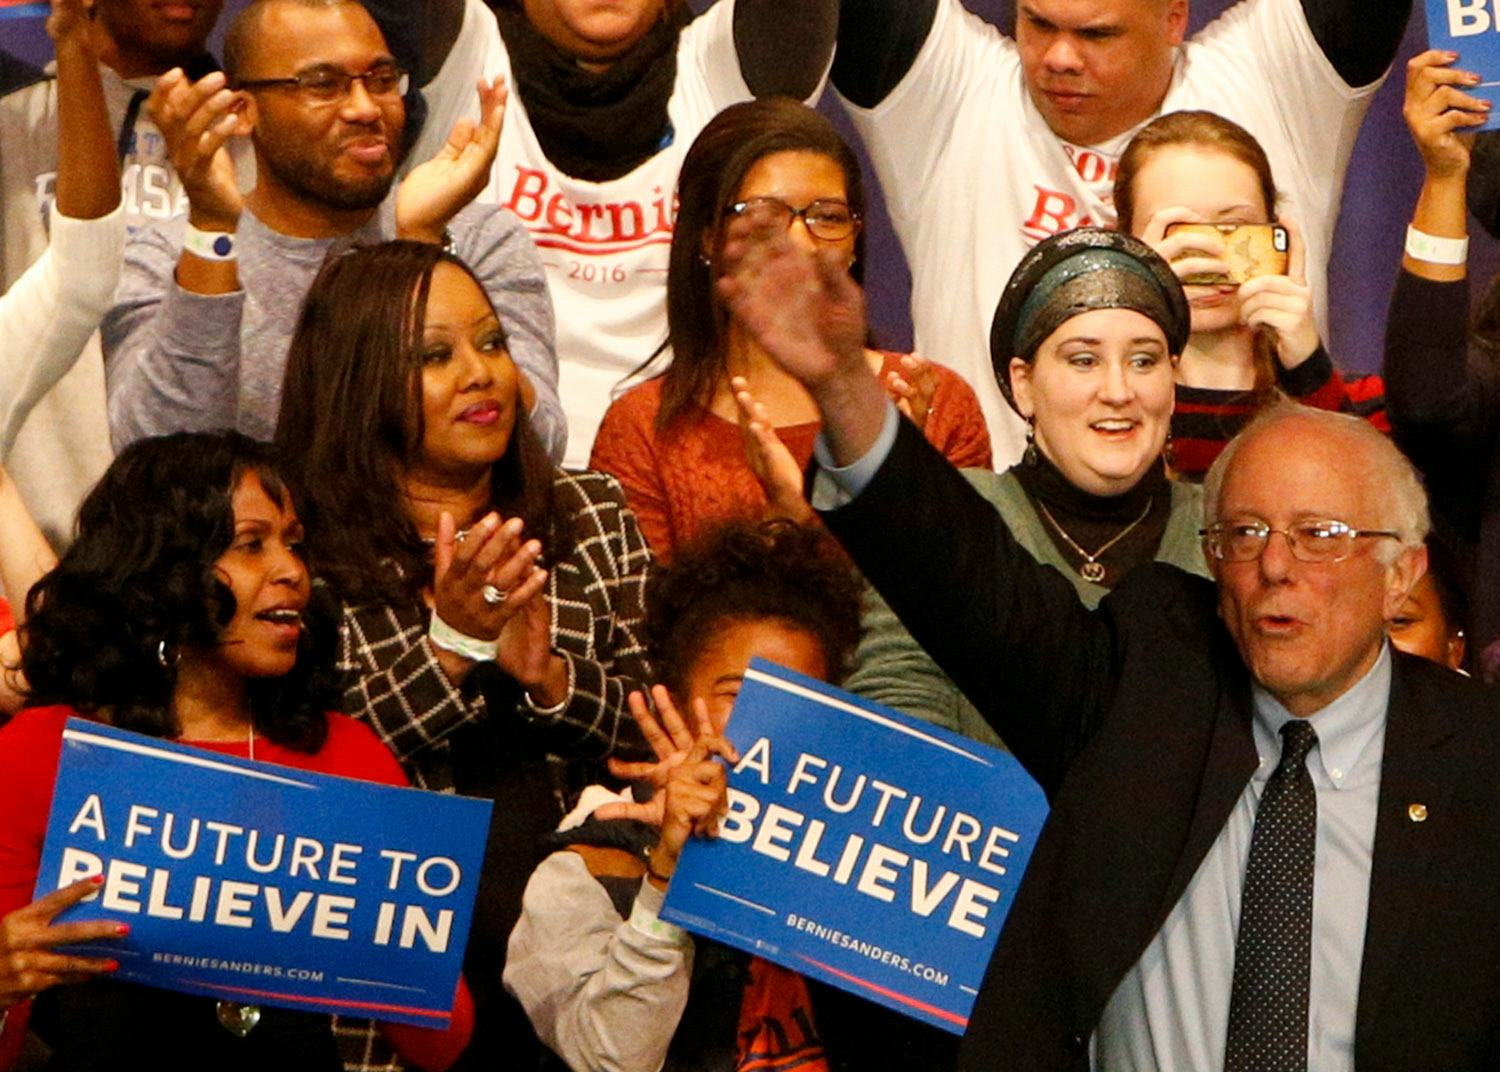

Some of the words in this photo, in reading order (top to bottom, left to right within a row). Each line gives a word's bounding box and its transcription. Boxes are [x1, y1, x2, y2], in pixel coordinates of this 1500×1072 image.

[502, 164, 681, 243] Berni
[567, 260, 627, 284] 2016
[68, 794, 106, 841] A
[124, 804, 363, 885] FUTURE
[380, 849, 461, 896] TO
[733, 737, 771, 784] A
[786, 753, 1020, 876] FUTURE
[57, 846, 357, 940] BELIEVE
[373, 902, 454, 953] IN
[718, 787, 1000, 939] BELIEVE
[152, 952, 324, 982] BERNIESANDERS.COM
[786, 913, 950, 987] BERNIESANDERS.COM
